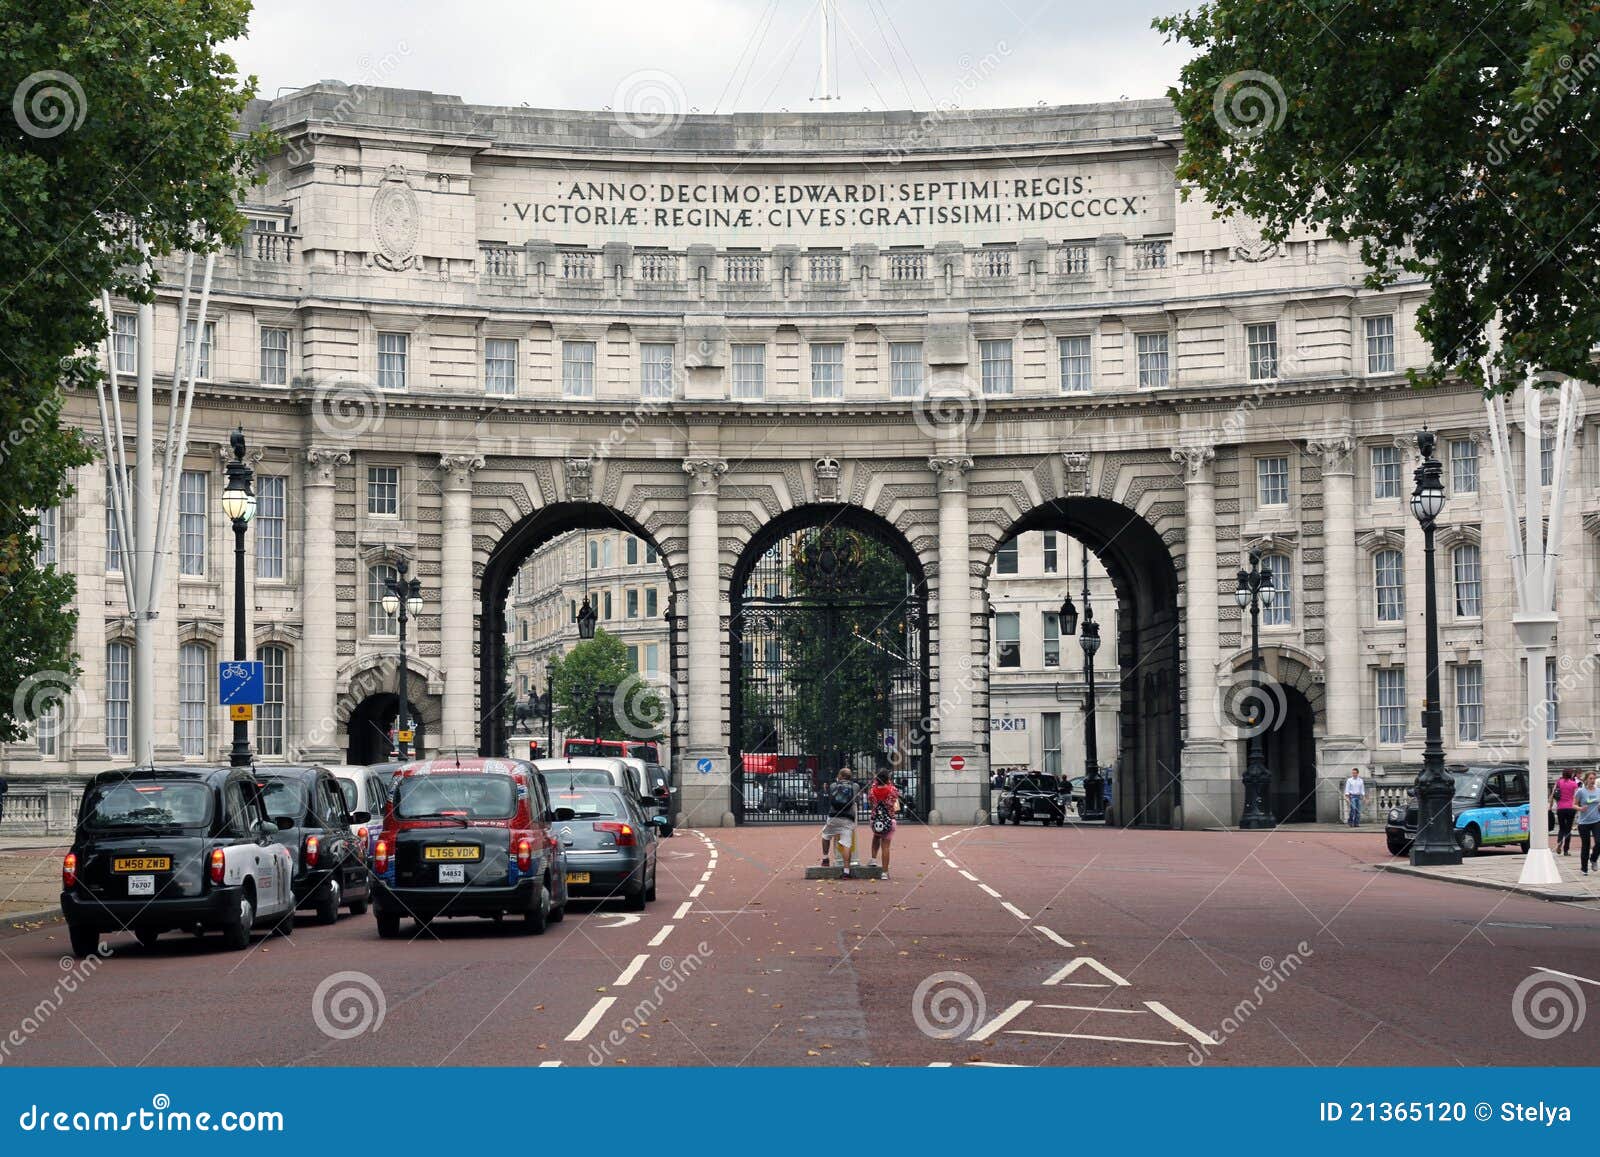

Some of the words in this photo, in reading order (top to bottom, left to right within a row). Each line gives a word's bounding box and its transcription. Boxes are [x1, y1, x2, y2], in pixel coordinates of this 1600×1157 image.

[567, 182, 647, 201] ANNO
[660, 184, 760, 204] DECIMO
[774, 184, 886, 204] EDWARDI
[899, 180, 1003, 202] SEPTIMI
[1012, 175, 1085, 198] REGIS
[768, 208, 847, 228] CIVES
[859, 203, 1001, 226] GRATISSIMI
[1016, 196, 1138, 222] MDCCCCX
[429, 848, 454, 858] LT56
[118, 859, 144, 870] LM58
[441, 870, 462, 878] 94852
[131, 881, 152, 889] 76707
